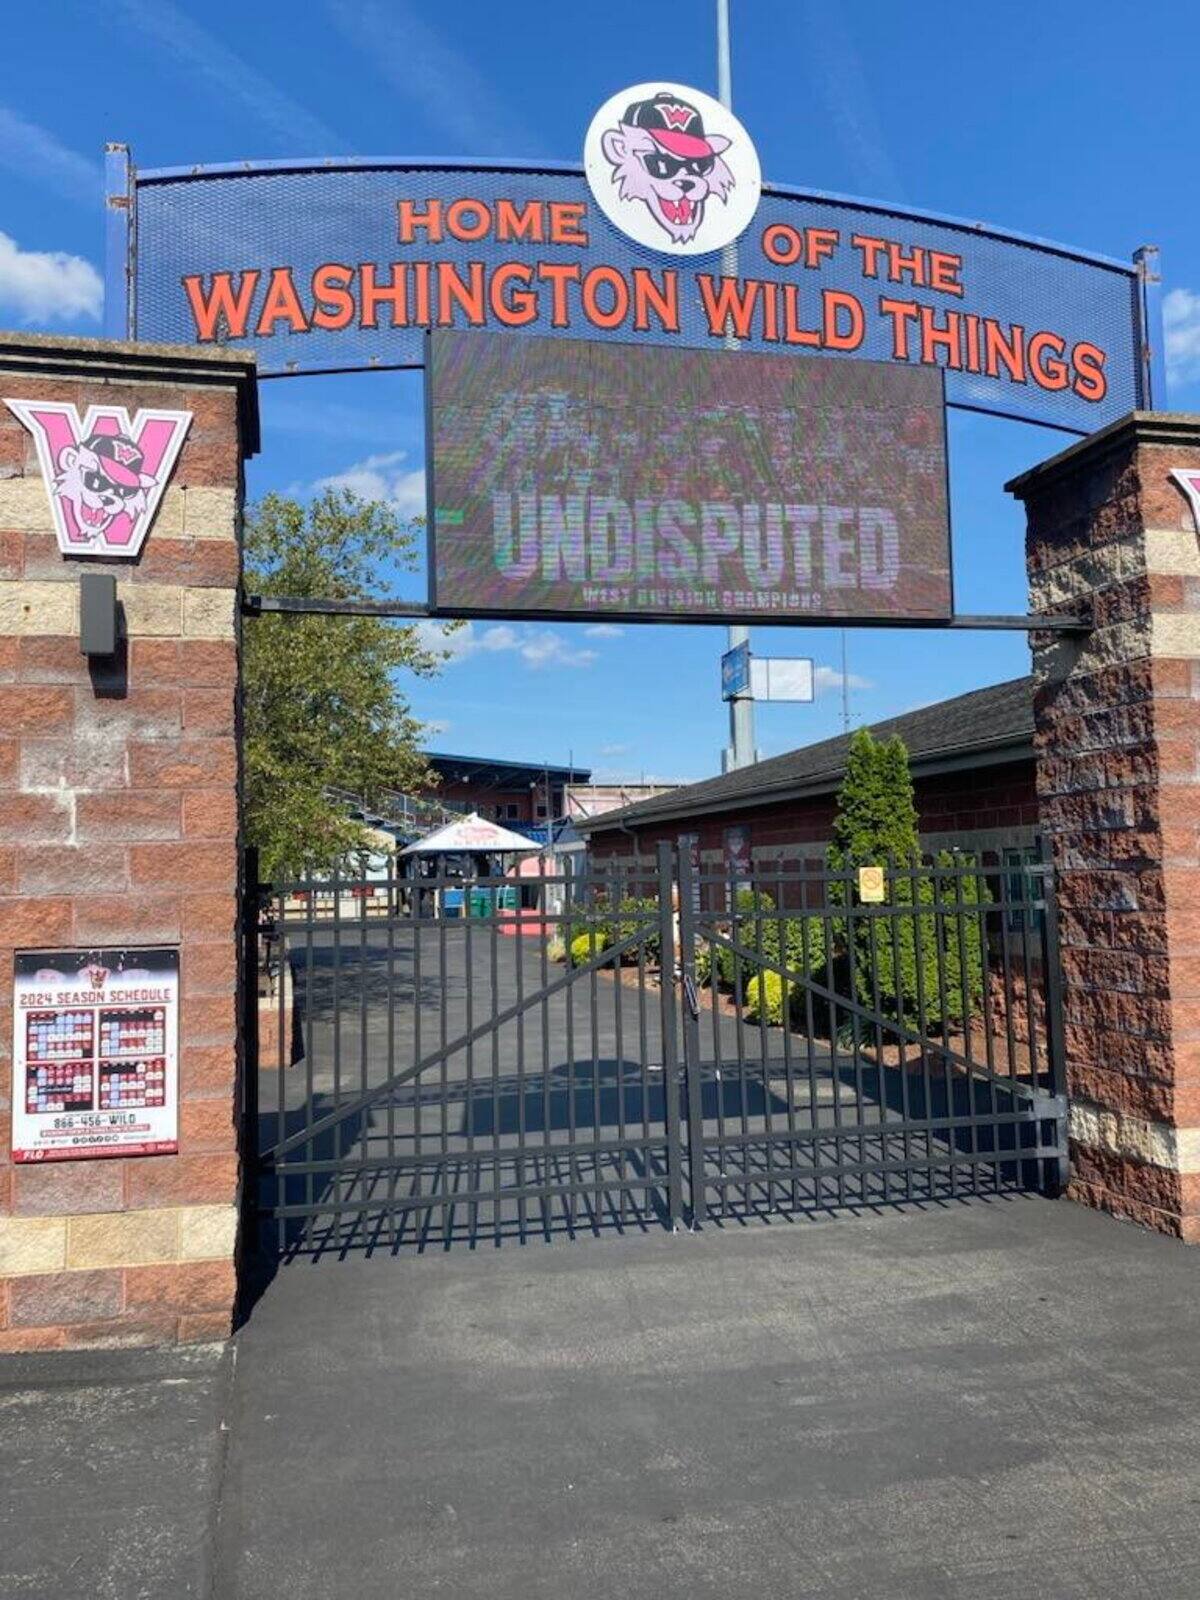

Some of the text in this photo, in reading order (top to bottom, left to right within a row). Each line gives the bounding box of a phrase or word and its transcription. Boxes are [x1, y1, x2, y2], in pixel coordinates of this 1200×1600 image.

[397, 197, 964, 297] HOME OF THE
[181, 261, 1108, 402] WASHINGTON WILD THINGS
[2, 397, 194, 558] W
[491, 491, 900, 592] UNDISPUTED
[582, 586, 822, 610] WEST DIVISION CHAMPIONS
[20, 988, 171, 1005] 2024 SEASON SCHEDULE
[53, 1113, 136, 1128] 866-456-WILD
